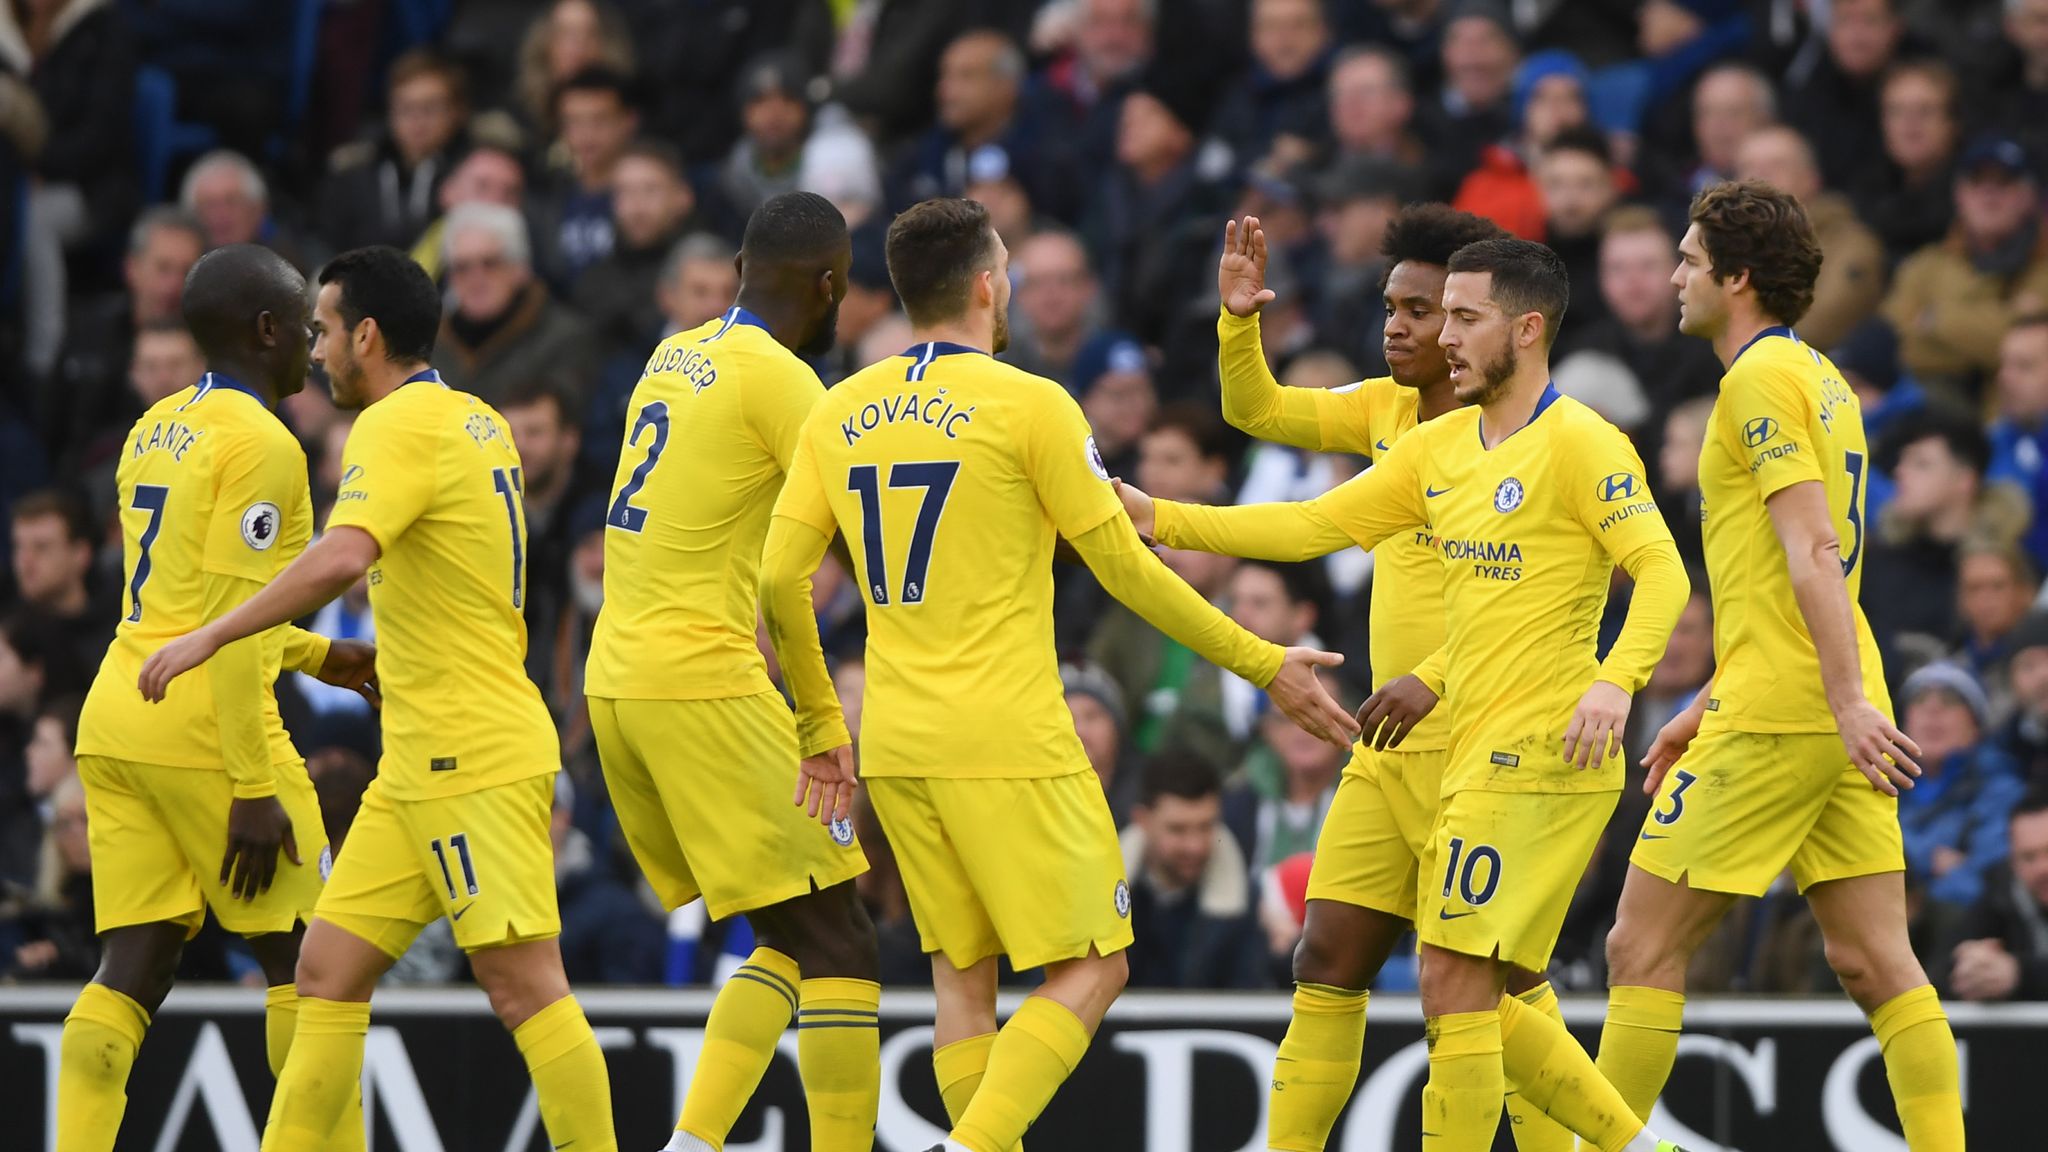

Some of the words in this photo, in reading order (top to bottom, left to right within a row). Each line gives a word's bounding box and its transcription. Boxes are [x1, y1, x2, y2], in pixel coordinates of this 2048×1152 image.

[133, 420, 204, 462] KANTÉ
[841, 388, 976, 447] KOVAČIĆ
[607, 401, 669, 533] 2
[847, 461, 960, 605] 17
[1598, 502, 1658, 533] HYUNDA
[1841, 450, 1863, 579] 3
[130, 484, 170, 622] 7
[1474, 564, 1522, 581] TYRES
[1653, 768, 1698, 826] 3
[430, 833, 480, 901] 11
[1442, 837, 1502, 907] 10
